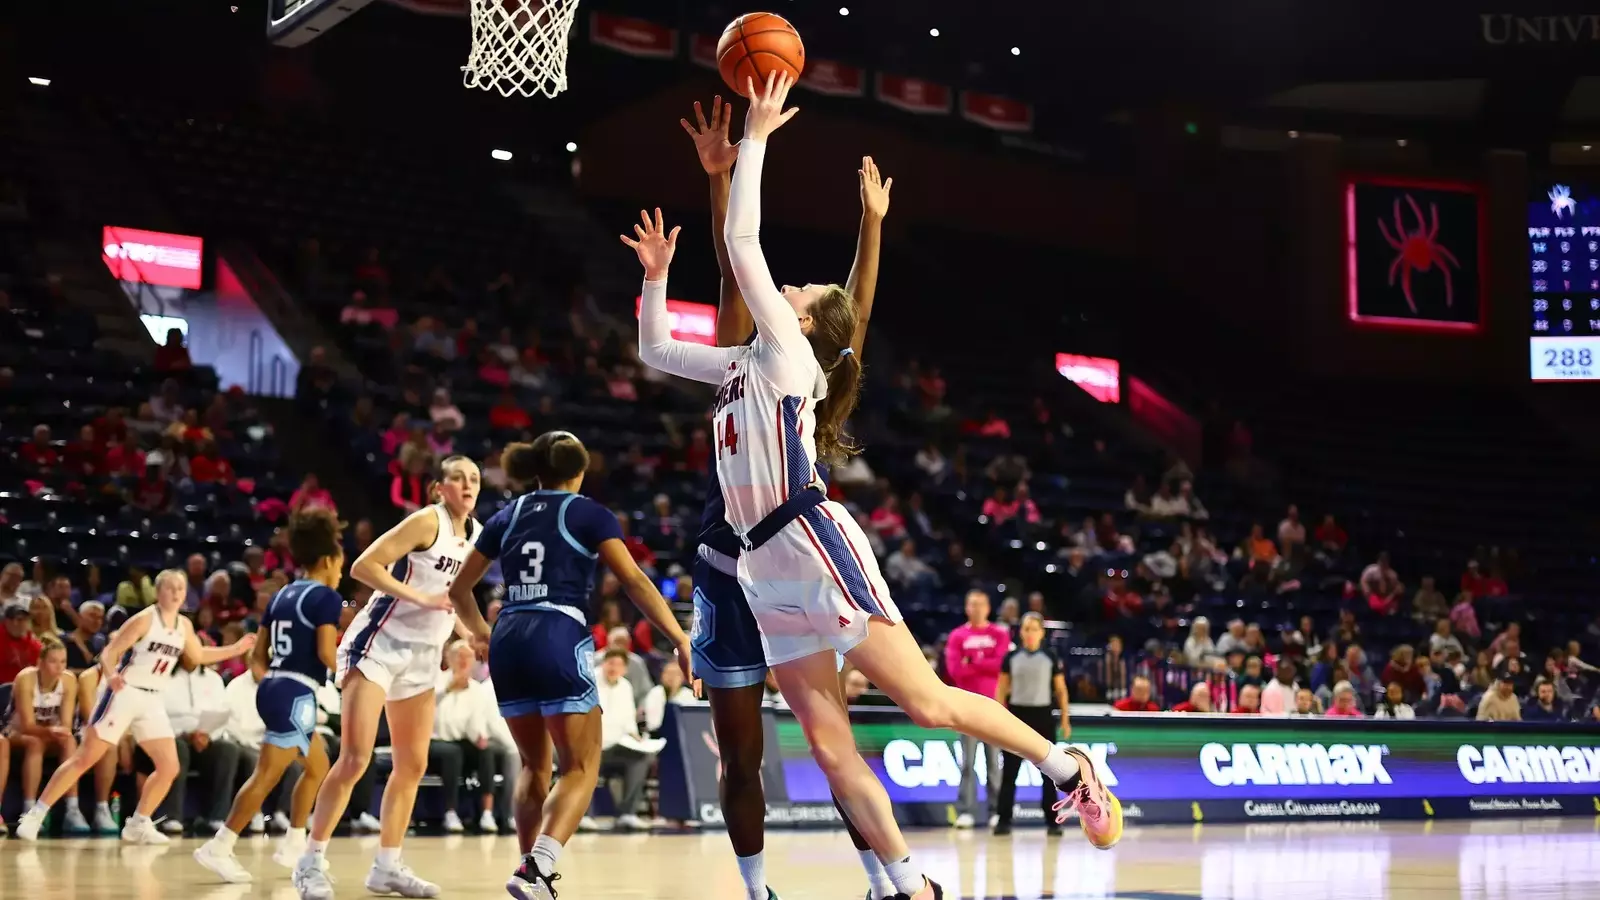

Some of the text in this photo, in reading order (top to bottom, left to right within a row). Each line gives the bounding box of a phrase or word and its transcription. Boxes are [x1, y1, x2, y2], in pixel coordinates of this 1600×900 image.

[1543, 347, 1593, 367] 288
[519, 541, 545, 584] 3
[270, 619, 293, 657] 15
